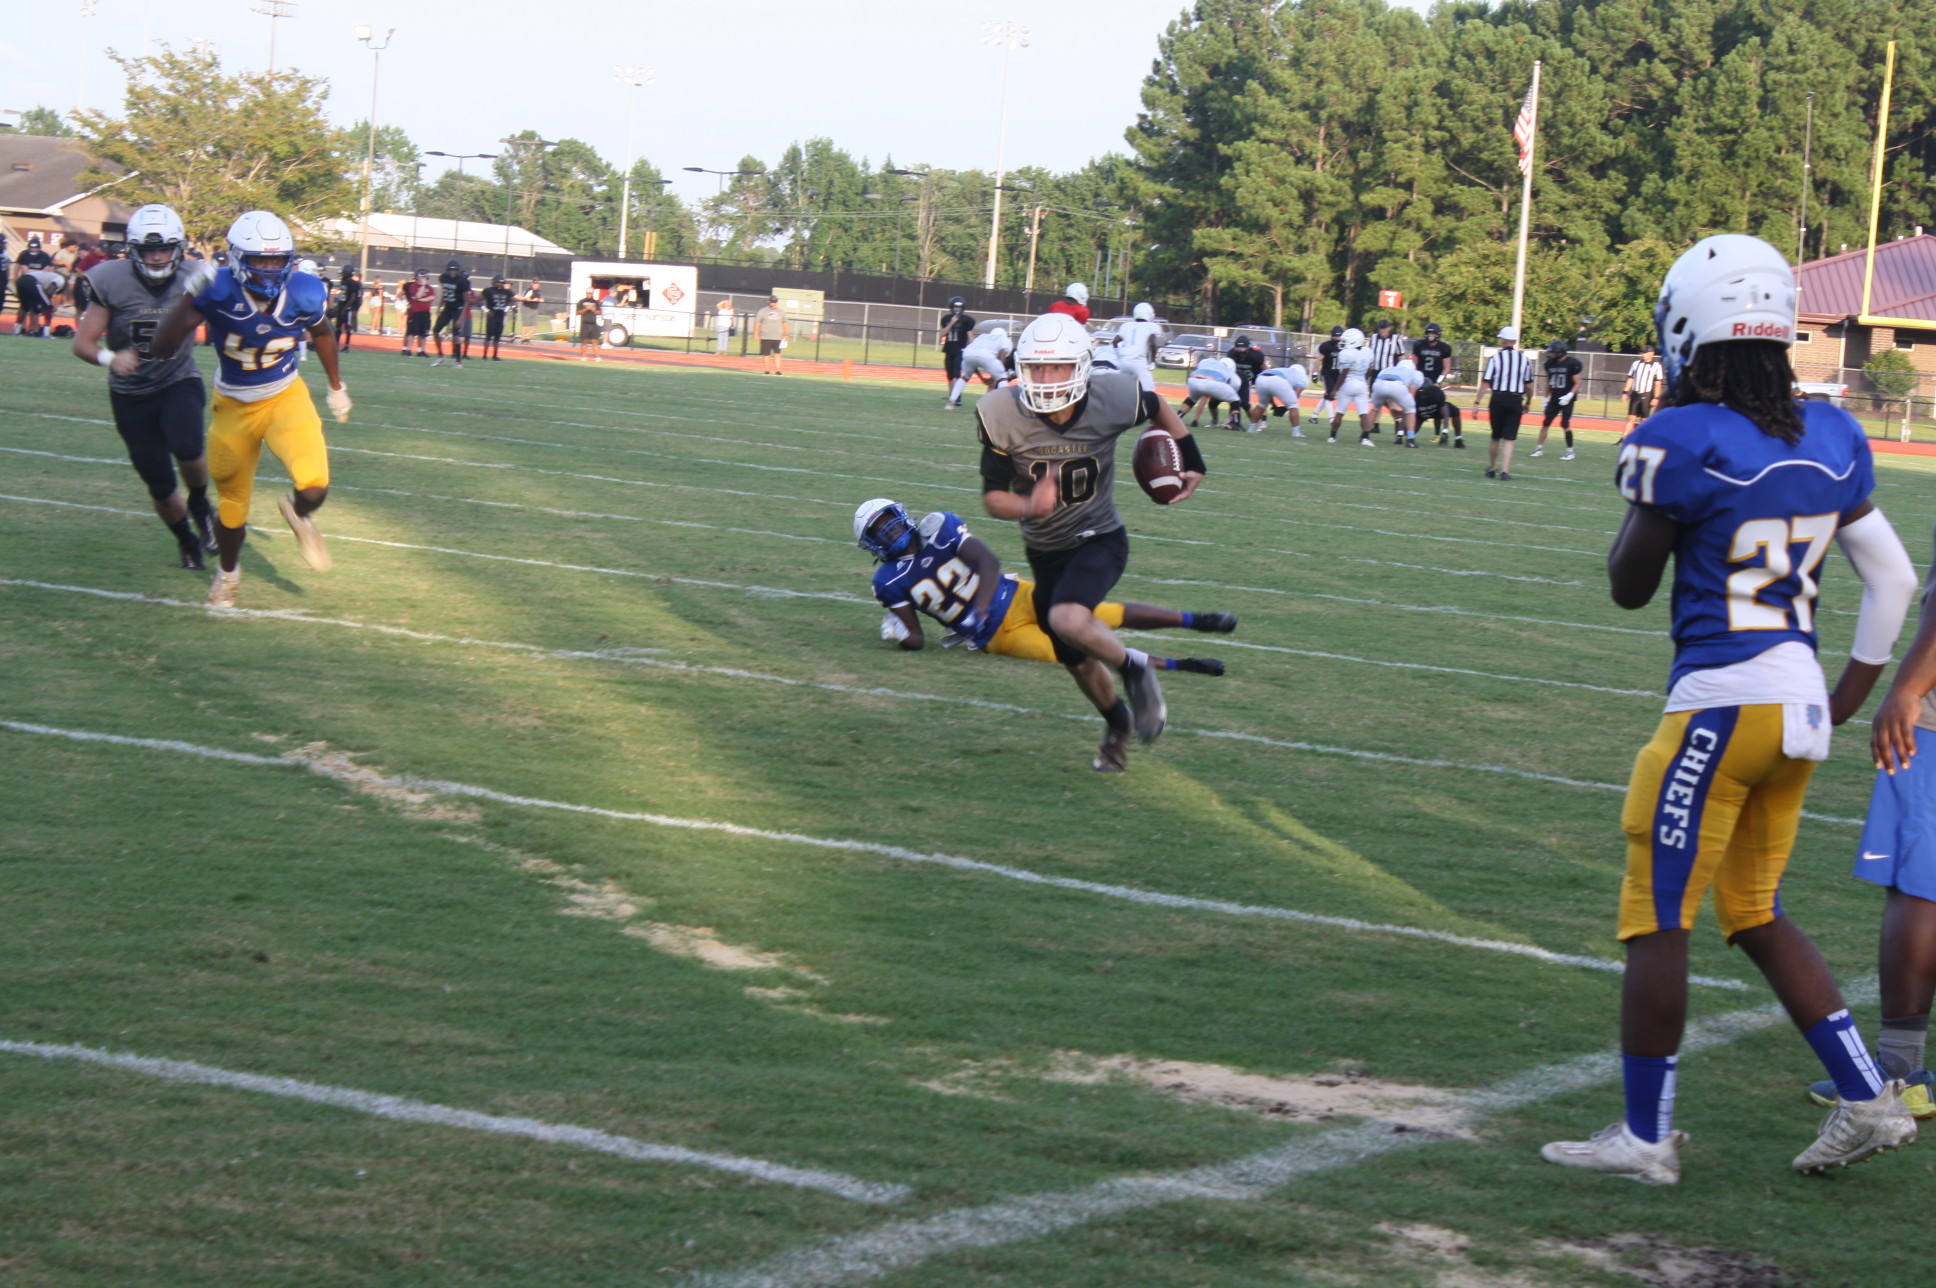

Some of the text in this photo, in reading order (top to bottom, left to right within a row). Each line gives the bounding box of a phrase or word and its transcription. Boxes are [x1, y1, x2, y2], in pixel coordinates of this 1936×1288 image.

[1387, 296, 1394, 307] 1
[1732, 322, 1790, 339] Riddell
[1424, 356, 1435, 371] 2
[1549, 374, 1567, 389] 40
[1617, 443, 1667, 503] 27
[909, 556, 981, 624] 22
[1726, 511, 1841, 633] 27
[1659, 727, 1719, 850] CHIEFS
